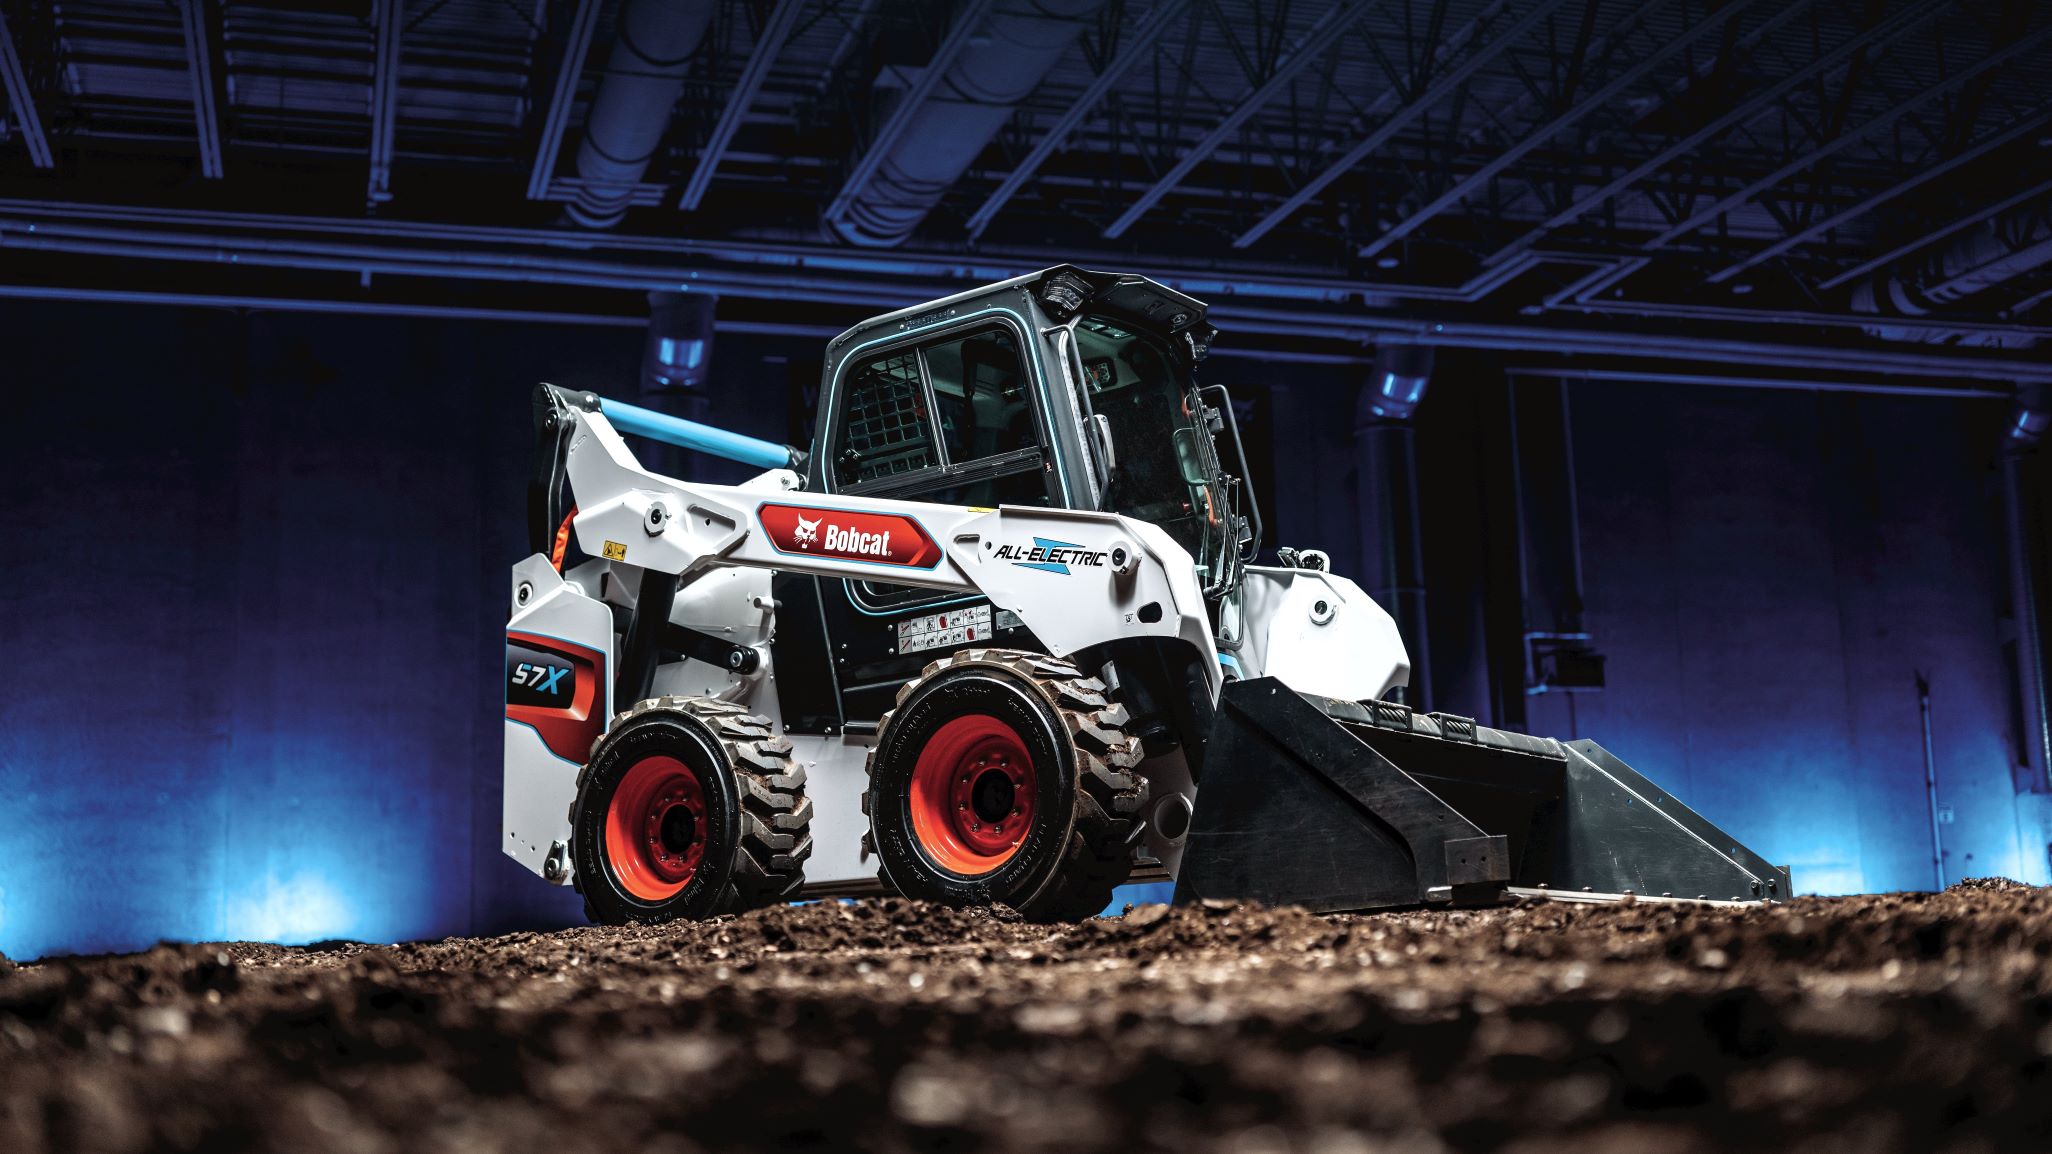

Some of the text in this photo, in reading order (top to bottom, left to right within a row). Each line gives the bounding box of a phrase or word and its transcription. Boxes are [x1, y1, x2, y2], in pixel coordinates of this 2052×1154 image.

[824, 524, 890, 556] Bobcat
[993, 544, 1108, 567] ALL-ELECTRIC
[511, 662, 570, 695] S7X
